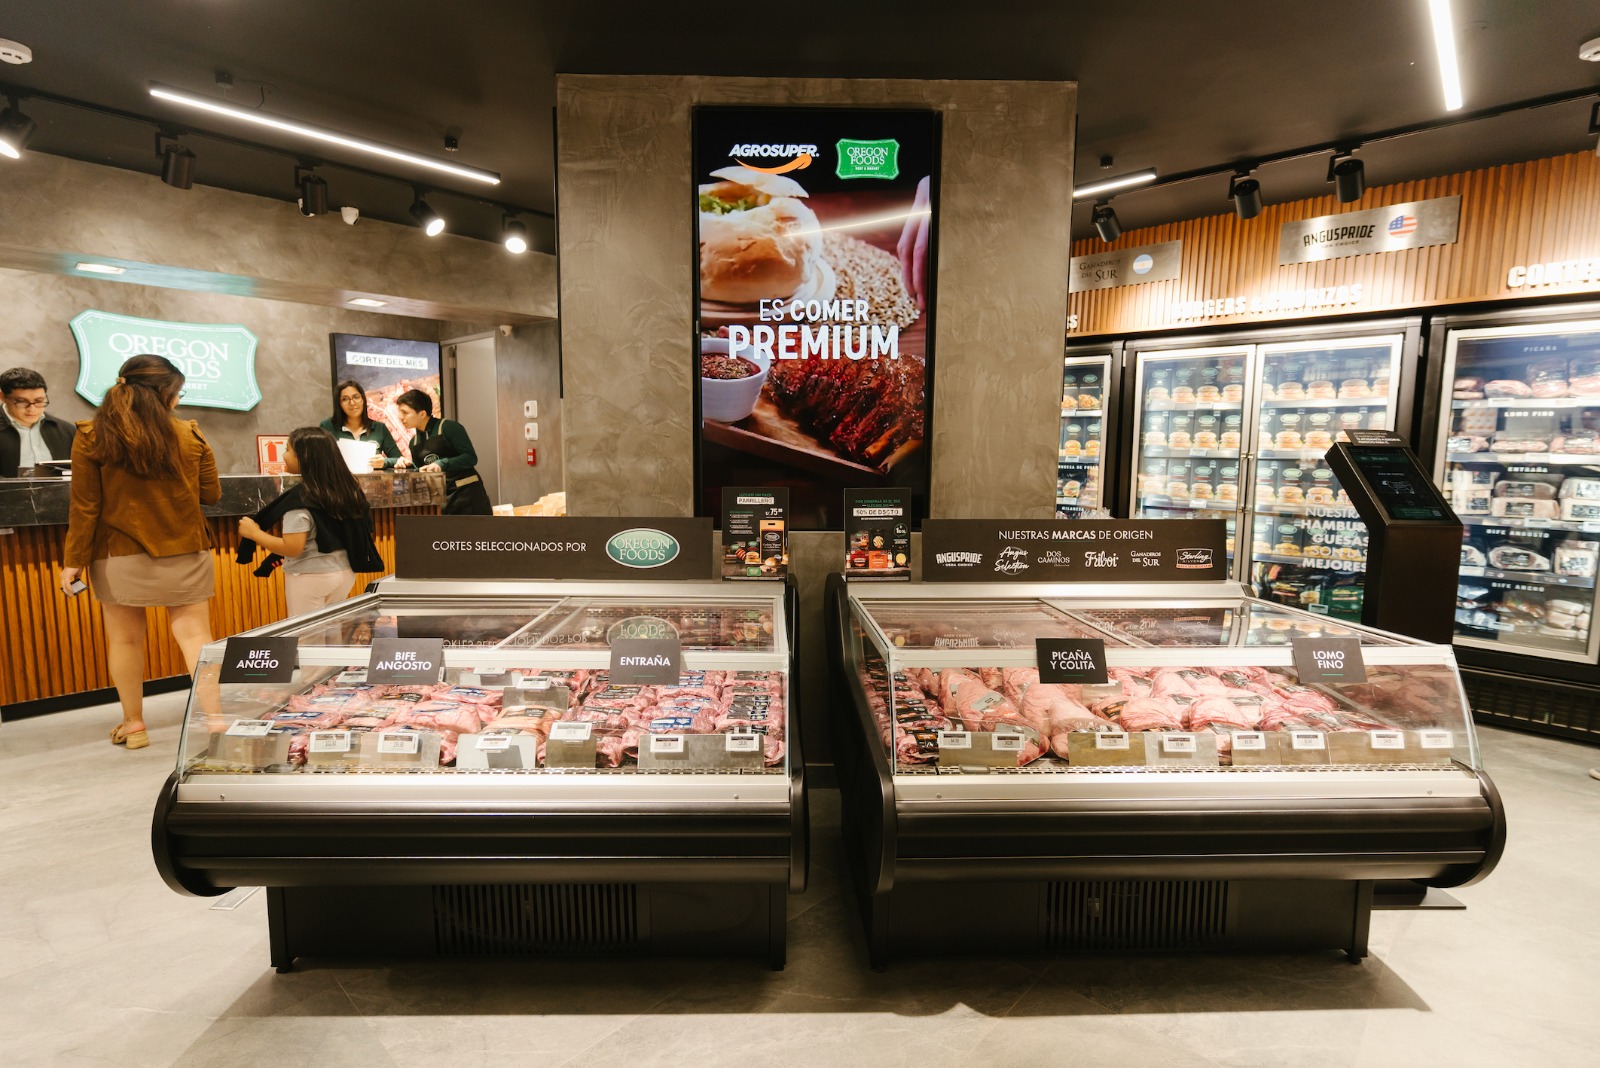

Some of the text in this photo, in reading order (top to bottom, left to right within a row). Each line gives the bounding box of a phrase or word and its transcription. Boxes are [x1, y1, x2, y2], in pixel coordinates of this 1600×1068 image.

[846, 147, 889, 157] OREGON
[850, 156, 885, 165] FOODS
[1303, 224, 1376, 247] ANGUSPRIDE
[1094, 269, 1118, 283] SUR
[759, 299, 869, 322] ES COMER
[108, 332, 229, 362] OREGON
[728, 324, 899, 361] PREMIUM
[352, 354, 424, 368] CORTE DEL MES
[998, 530, 1153, 540] NUESTRAS MARCAS DE ORIGEN
[1509, 530, 1550, 538] ANGOSTO
[614, 535, 671, 551] OREGON
[1312, 534, 1369, 547] GUESAS
[432, 541, 587, 553] CORTES SELECCIONADOS POR
[1000, 546, 1028, 560] Angus
[619, 547, 666, 561] FOODS
[936, 551, 983, 564] ANGUSPRIDE
[1037, 556, 1070, 564] CAMINOS
[1084, 550, 1119, 568] Friboi
[1179, 550, 1210, 563] Sterling
[1142, 557, 1160, 567] SUR
[1302, 558, 1367, 573] MEJORES
[1514, 584, 1545, 592] ANCHO
[248, 649, 271, 660] BIFE
[394, 651, 417, 661] BIFE
[619, 654, 671, 667] ENTRAÑA
[1051, 649, 1092, 661] PICAÑA
[1312, 650, 1345, 660] LOMO
[236, 659, 279, 669] ANCHO
[376, 660, 432, 671] ANGOSTO
[1050, 661, 1096, 670] Y COLITA
[1317, 659, 1344, 670] FINO
